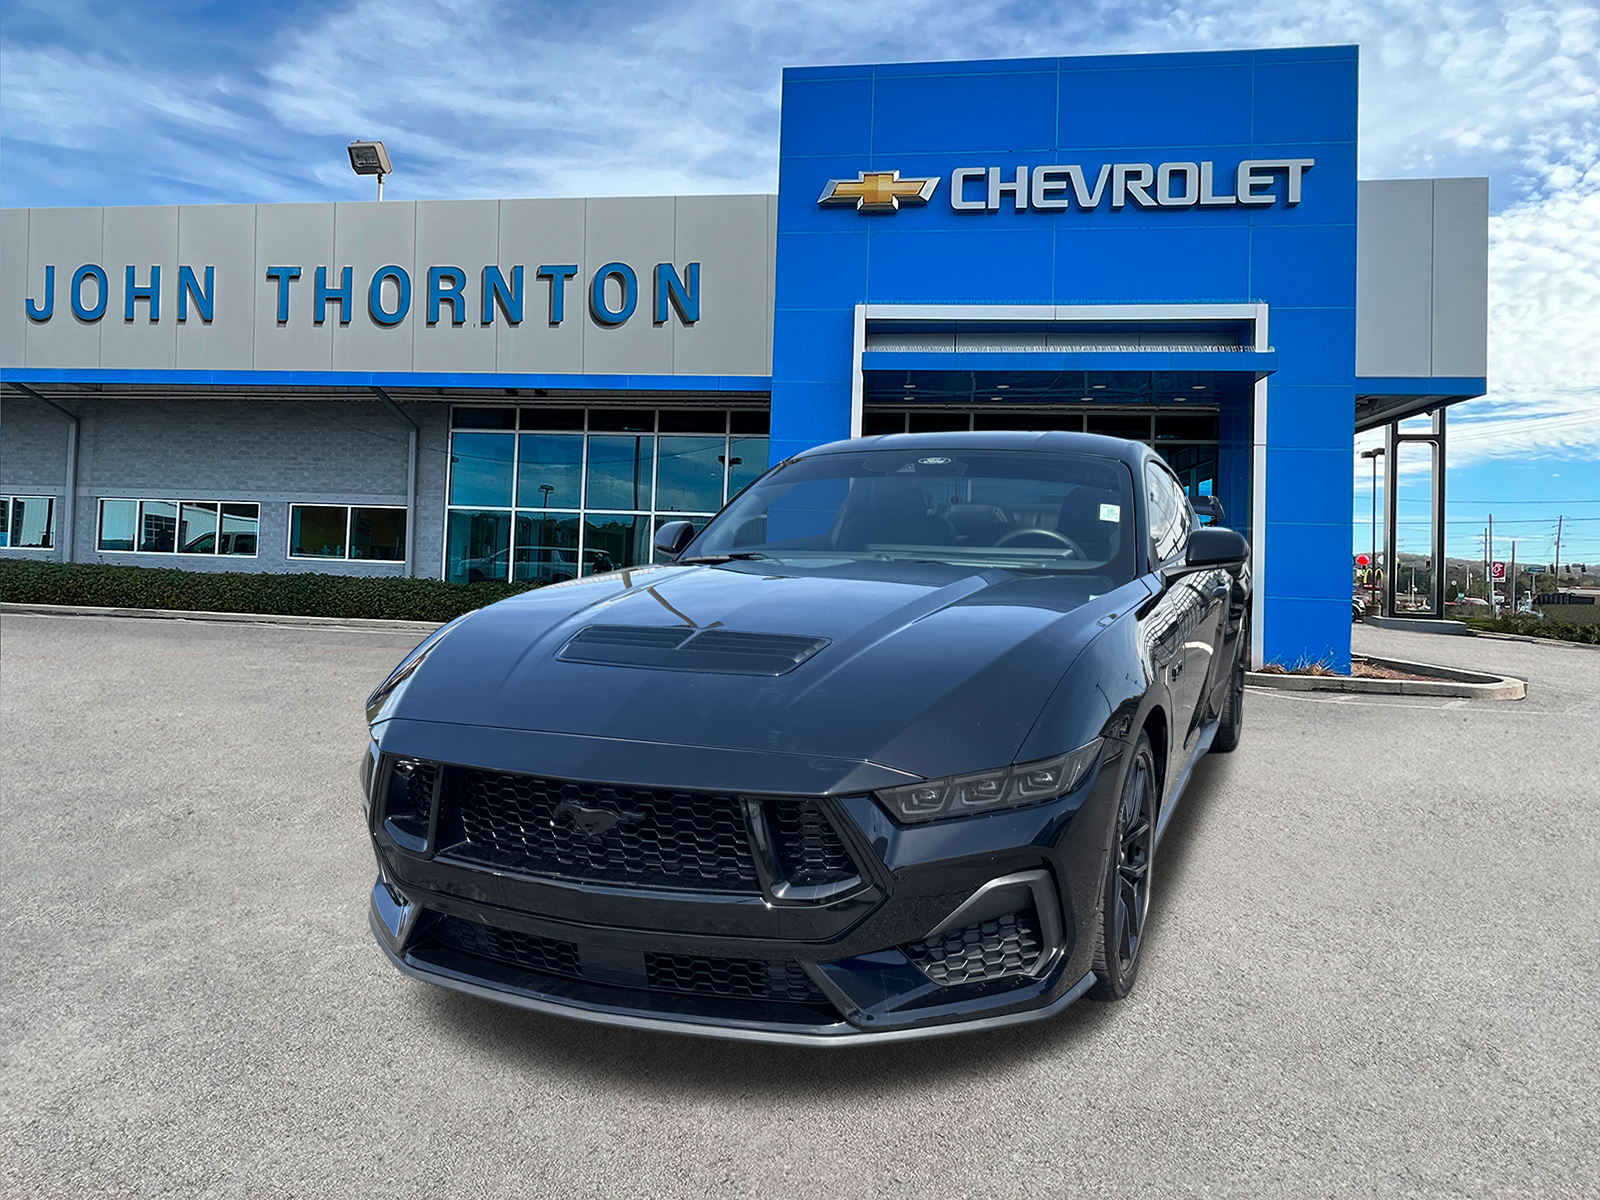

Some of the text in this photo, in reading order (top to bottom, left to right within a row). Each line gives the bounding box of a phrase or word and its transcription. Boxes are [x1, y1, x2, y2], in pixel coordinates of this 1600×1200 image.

[951, 158, 1315, 211] CHEVROLET
[25, 261, 701, 327] JOHN THORNTON
